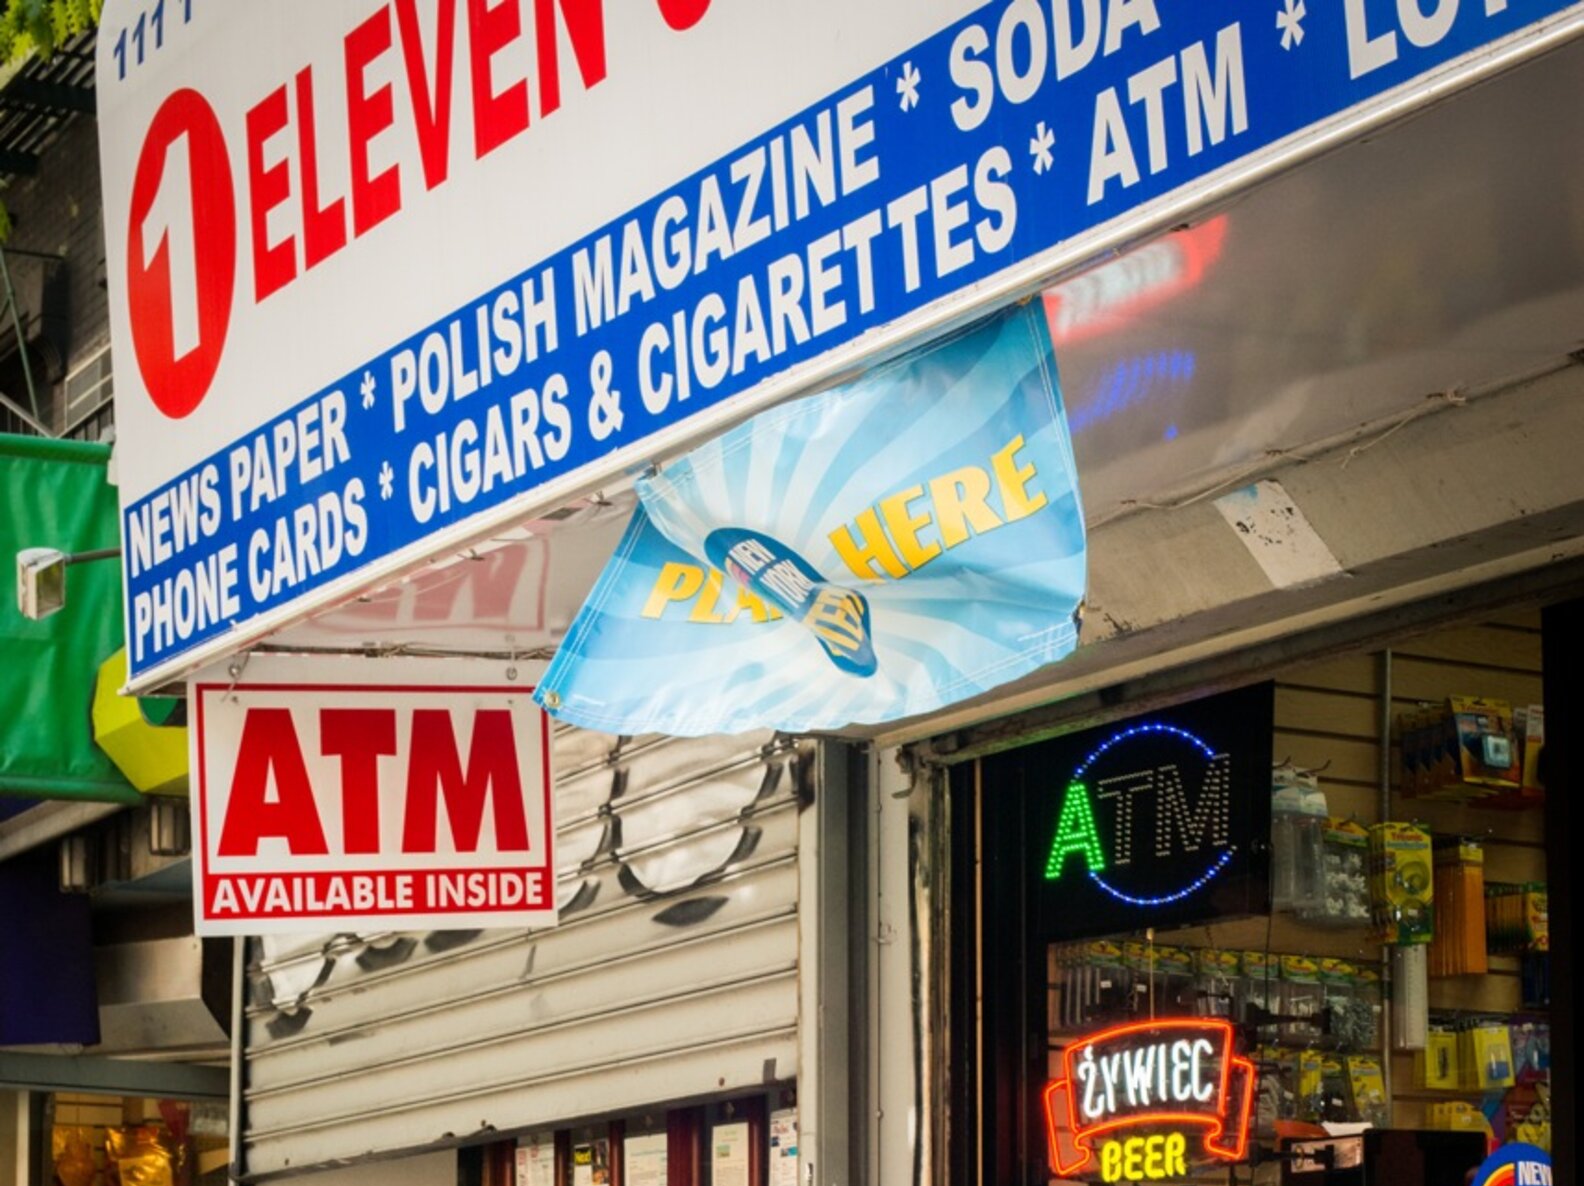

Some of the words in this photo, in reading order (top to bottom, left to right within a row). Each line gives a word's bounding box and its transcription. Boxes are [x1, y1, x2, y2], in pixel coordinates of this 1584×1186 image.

[141, 128, 200, 363] 1
[129, 464, 222, 579] NEWS
[229, 390, 351, 522] PAPER
[391, 267, 559, 433] POLISH
[572, 84, 880, 338] MAGAZINE
[134, 543, 240, 663] PHONE
[248, 477, 368, 603] CARDS
[408, 373, 572, 524] CIGARS
[588, 349, 624, 441] &
[638, 145, 1018, 415] CIGARETTES
[1087, 21, 1249, 206] ATM
[827, 433, 1048, 581] HERE
[217, 708, 530, 857] ATM
[1045, 753, 1231, 880] ATM
[211, 874, 414, 914] AVAILABLE
[426, 872, 543, 908] INSIDE
[1077, 1038, 1214, 1118] ŻYWIEC
[1100, 1131, 1187, 1183] BEER
